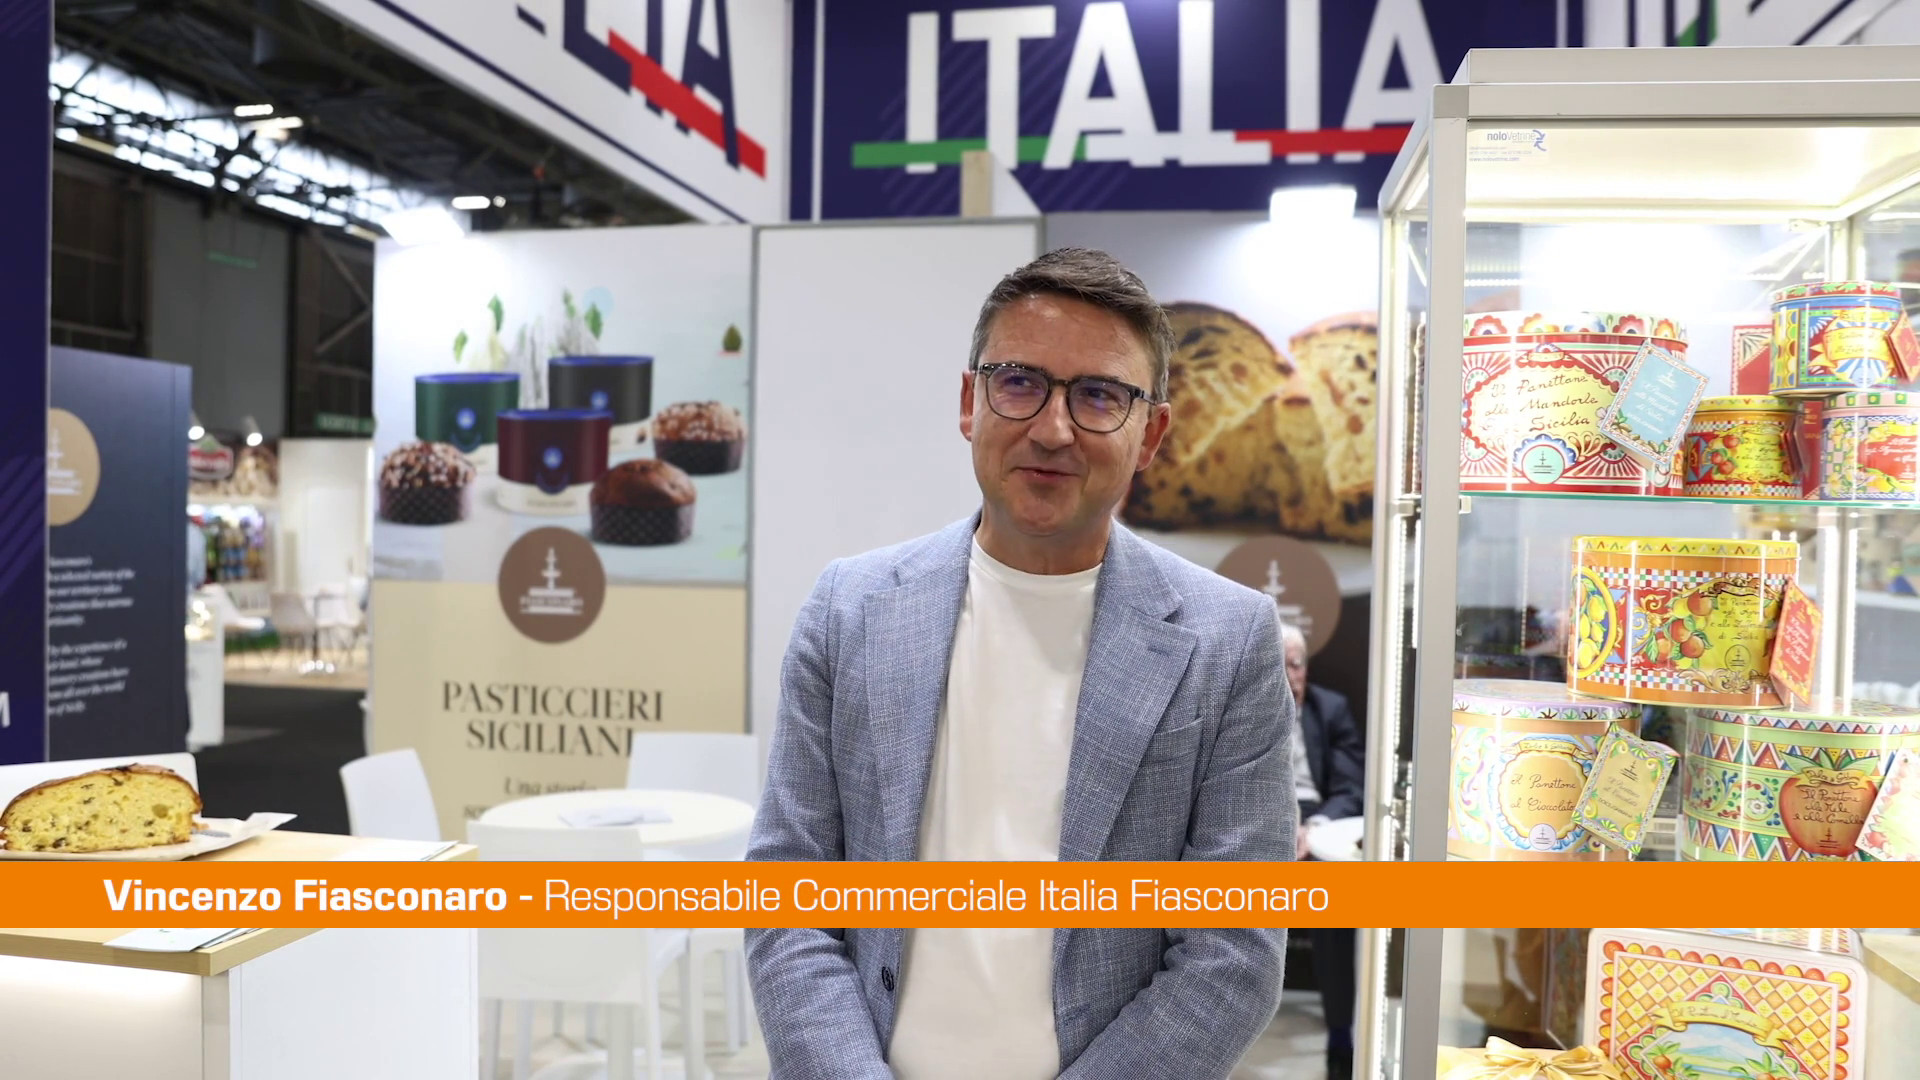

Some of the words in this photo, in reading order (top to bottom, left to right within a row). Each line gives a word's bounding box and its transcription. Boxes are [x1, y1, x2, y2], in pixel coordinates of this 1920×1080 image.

[904, 0, 1446, 174] ITALIA
[1520, 393, 1598, 412] Mandorle
[1529, 411, 1591, 432] Sicilia
[443, 680, 663, 722] PASTICCIERI
[467, 718, 633, 758] SICILIANI
[1529, 773, 1577, 789] Panettone
[1528, 797, 1576, 812] Cioccolato
